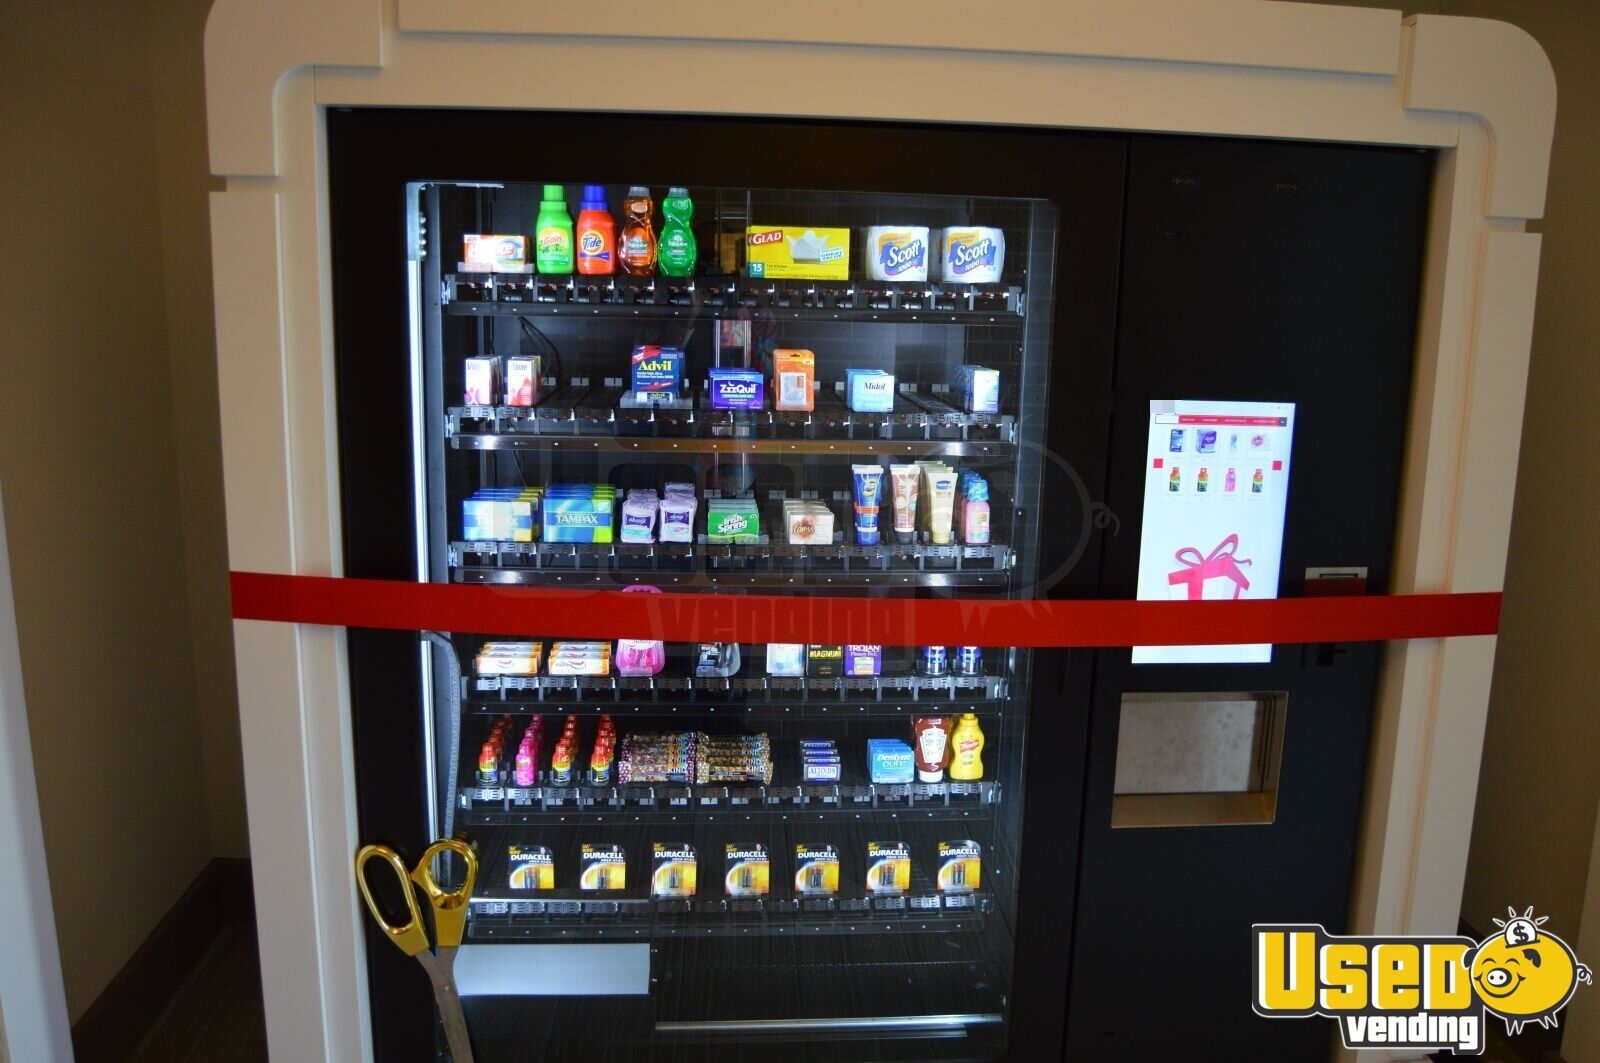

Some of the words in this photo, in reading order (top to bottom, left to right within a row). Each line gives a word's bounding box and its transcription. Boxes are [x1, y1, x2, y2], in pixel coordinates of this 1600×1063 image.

[544, 236, 561, 245] Gain
[752, 232, 782, 244] GLAD
[583, 237, 602, 250] Tide
[887, 240, 921, 267] Scott
[955, 239, 990, 266] Scott
[752, 263, 763, 272] 15
[638, 360, 672, 371] Advil
[720, 383, 757, 394] ZzzQuil
[863, 381, 886, 391] Midol
[555, 514, 598, 524] TAMPAX
[723, 514, 743, 525] Irish
[718, 520, 748, 534] Spring
[848, 644, 880, 652] TROJAN
[809, 650, 842, 658] MAGNUM
[809, 767, 836, 775] ALTOIDS
[728, 850, 767, 858] DURACELL
[798, 851, 837, 859] DURACELL
[869, 849, 909, 857] DURACELL
[940, 848, 979, 857] DURACELL
